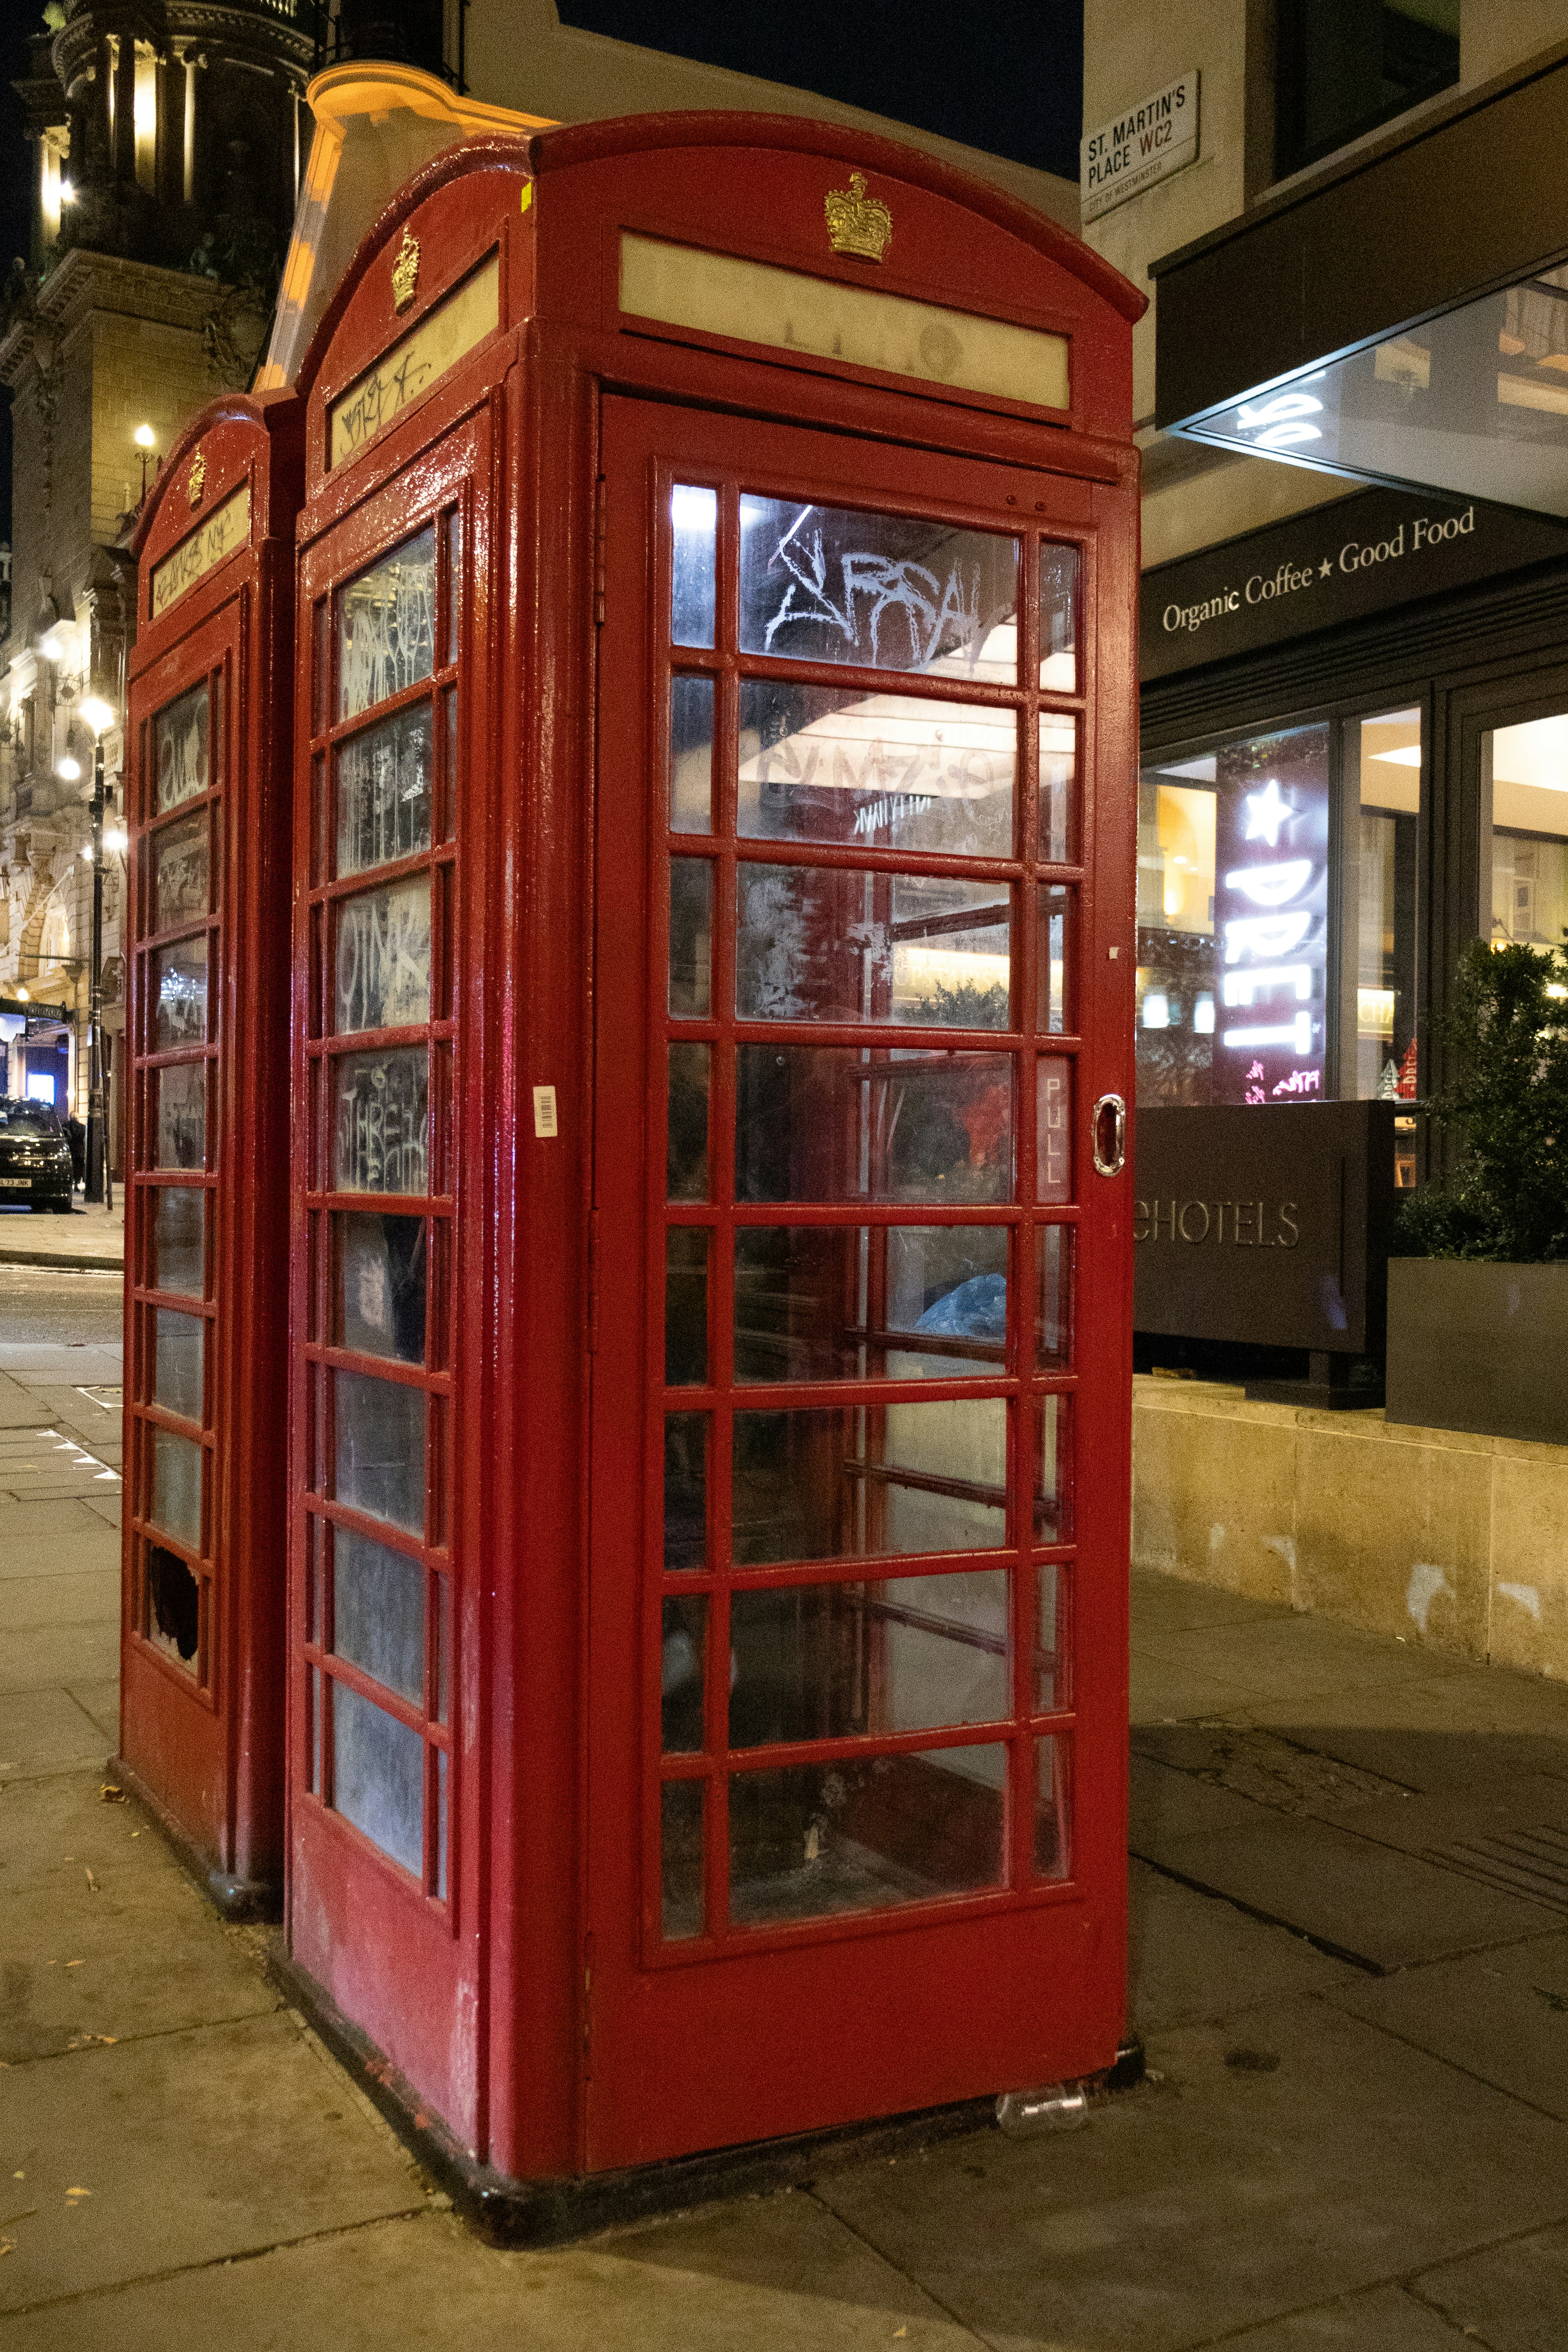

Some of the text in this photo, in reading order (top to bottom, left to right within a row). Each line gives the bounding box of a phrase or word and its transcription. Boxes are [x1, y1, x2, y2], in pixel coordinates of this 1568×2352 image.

[1088, 85, 1185, 162] ST. MARTIN'S
[1088, 120, 1173, 188] PLACE WC2
[1163, 506, 1476, 632] Organic Coffee Good Food
[1224, 860, 1312, 1054] PRET
[1047, 1078, 1061, 1183] PULL
